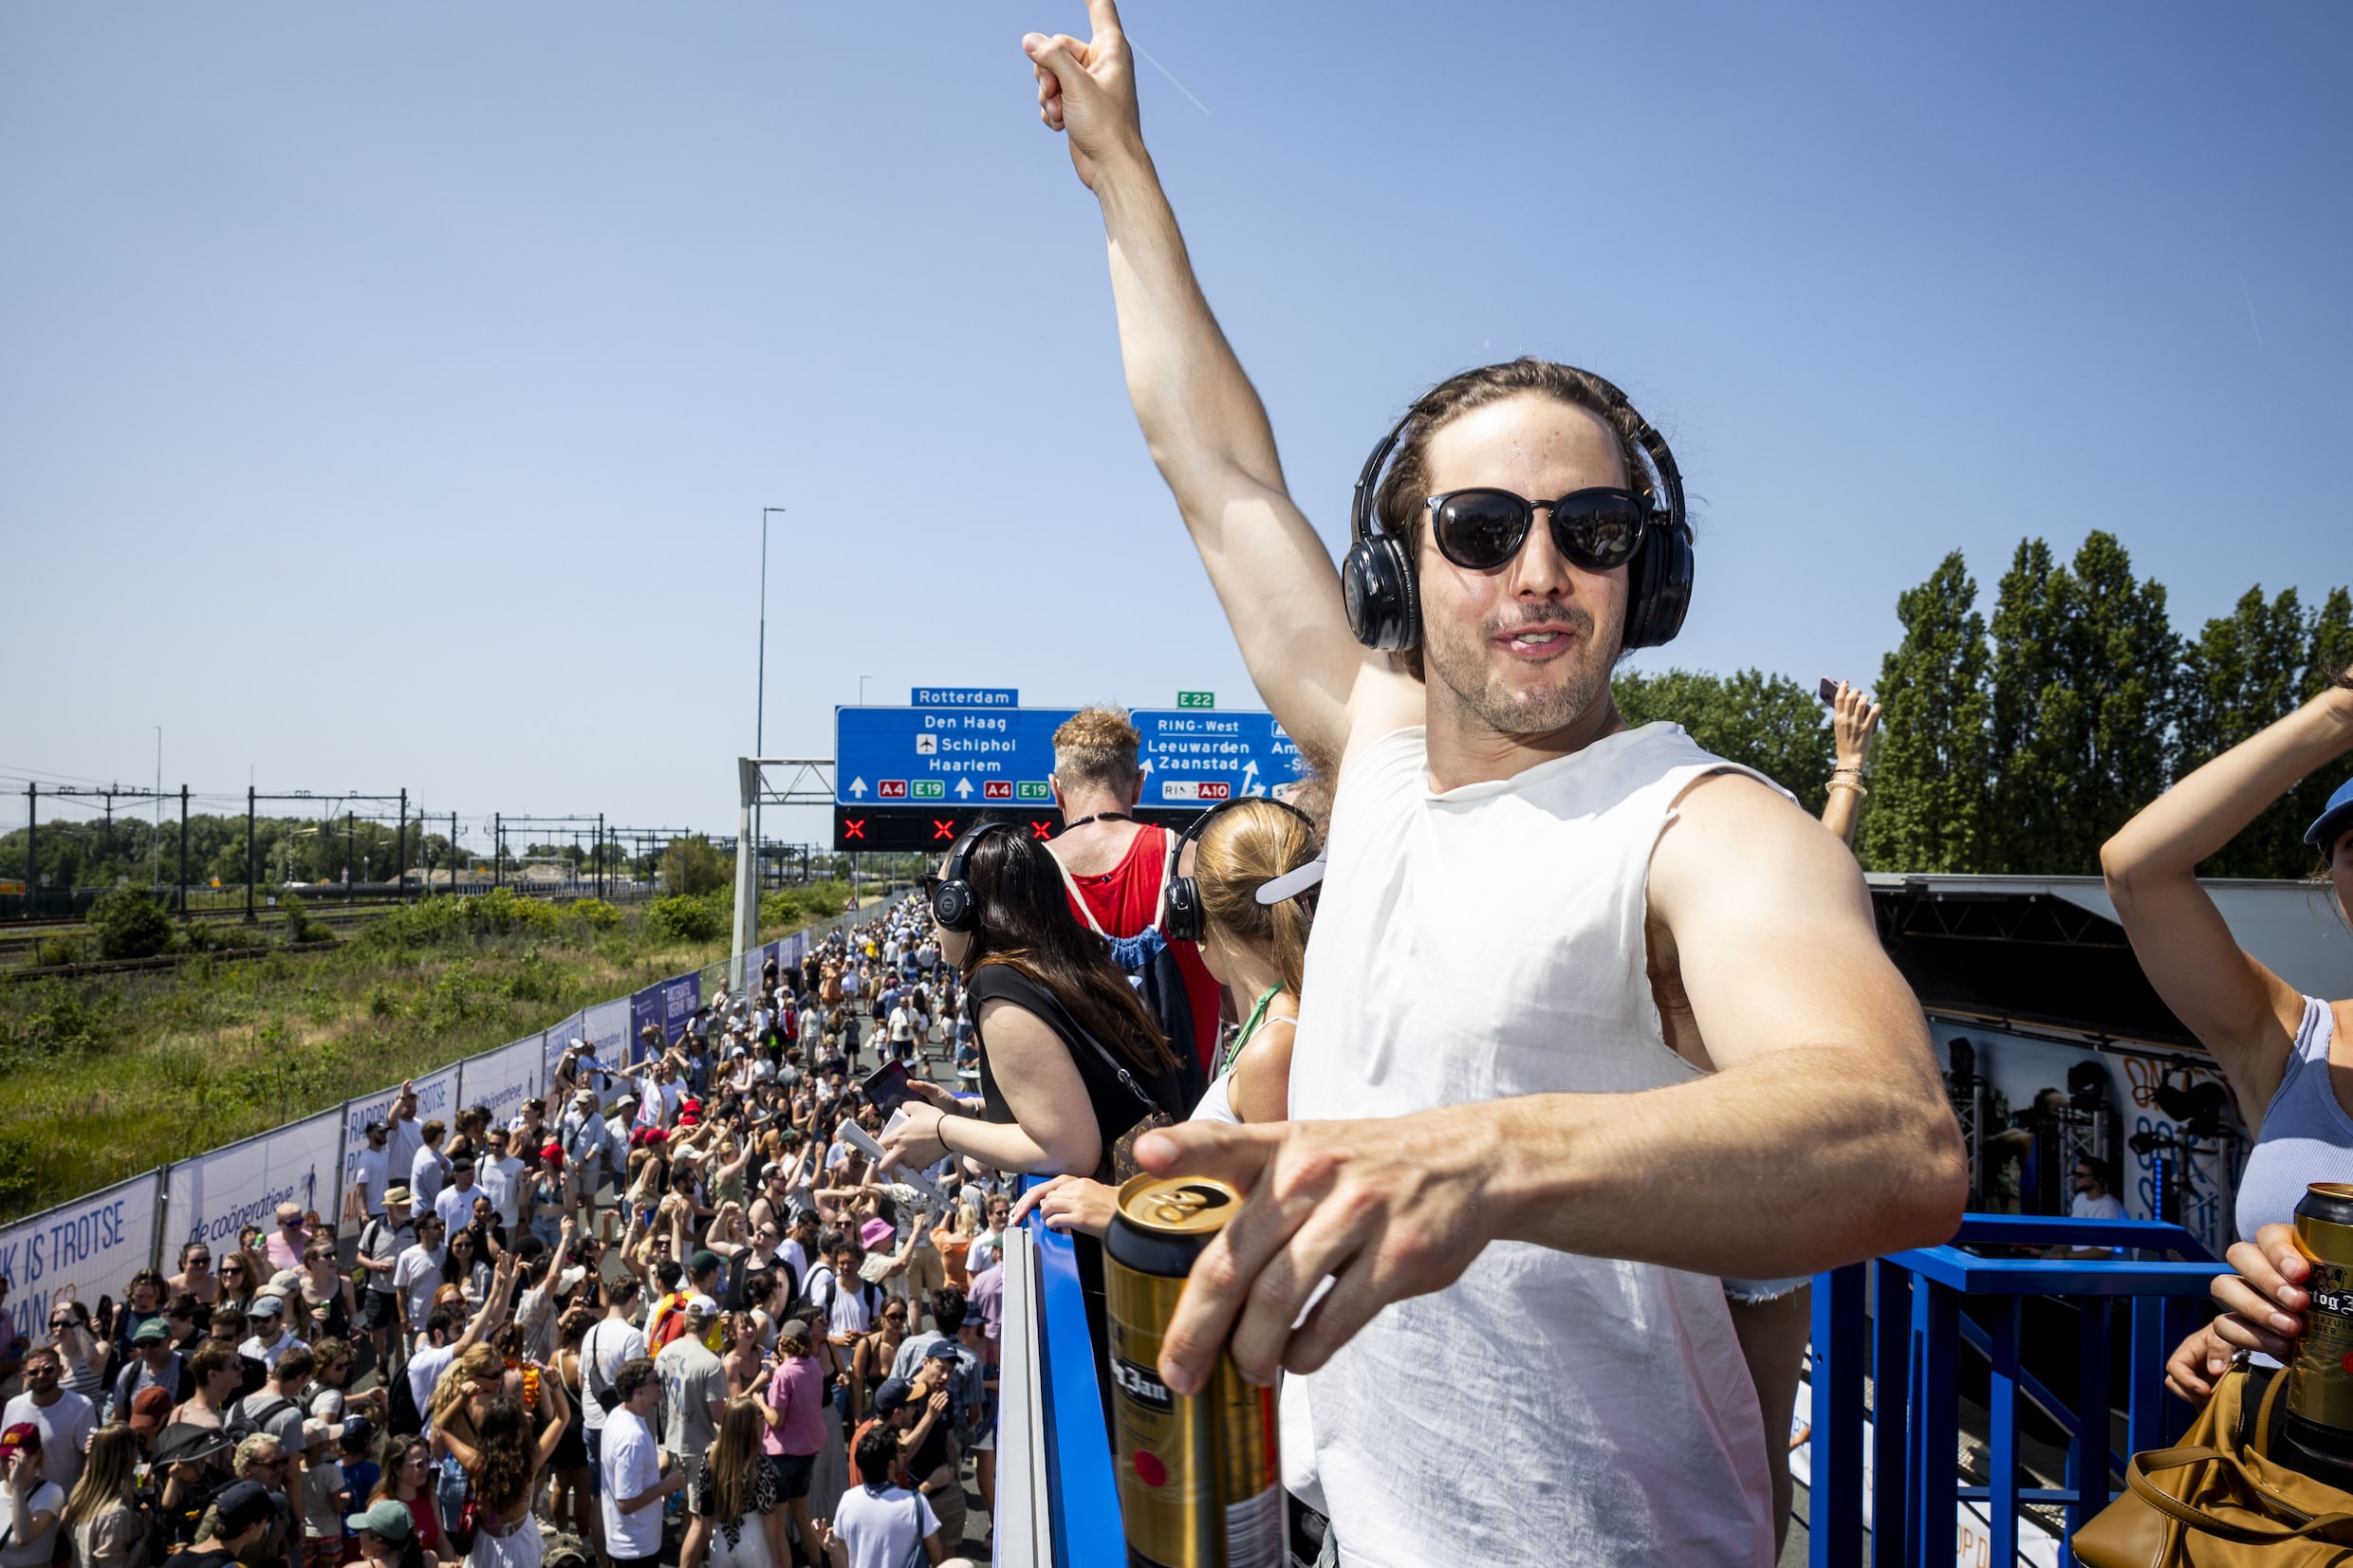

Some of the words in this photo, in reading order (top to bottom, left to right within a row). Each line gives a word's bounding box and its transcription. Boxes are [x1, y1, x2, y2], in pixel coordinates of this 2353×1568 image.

[919, 690, 1010, 704] Rotterdam
[924, 714, 957, 729] Den
[963, 715, 1007, 733] Haag
[941, 737, 1016, 753] Schiphol
[1147, 739, 1250, 754] Leeuwarden
[1271, 741, 1303, 755] Am
[929, 758, 1002, 772] Haarlem
[1158, 755, 1239, 771] Zaanstad
[880, 783, 905, 796] A4
[987, 784, 1010, 797] A4
[1199, 784, 1229, 798] A10
[24, 1233, 46, 1284] IS
[50, 1200, 124, 1272] TROTSE
